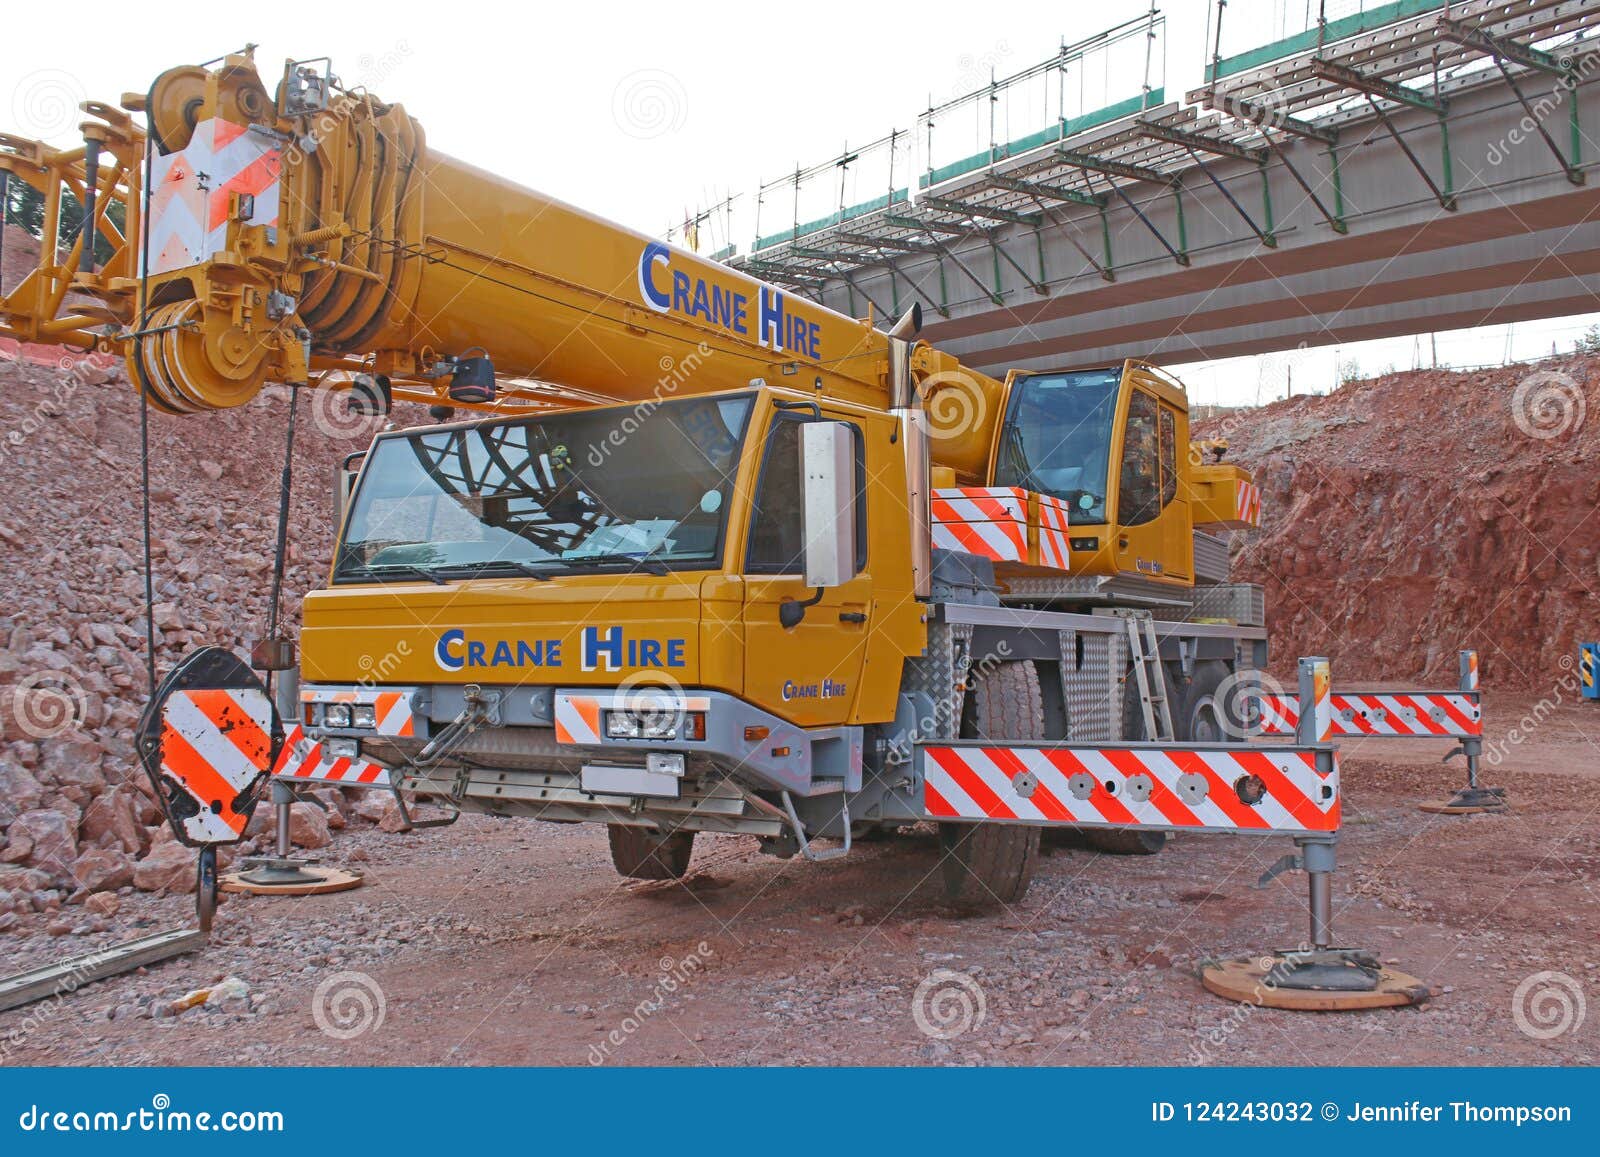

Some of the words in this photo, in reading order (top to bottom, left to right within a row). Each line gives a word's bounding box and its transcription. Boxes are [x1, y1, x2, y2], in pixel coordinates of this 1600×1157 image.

[638, 242, 748, 335] CRANE
[758, 284, 821, 361] HIRE
[433, 629, 562, 672] CRANE
[580, 626, 686, 672] HIRE
[781, 679, 818, 702] CRANE
[821, 678, 847, 699] HIRE
